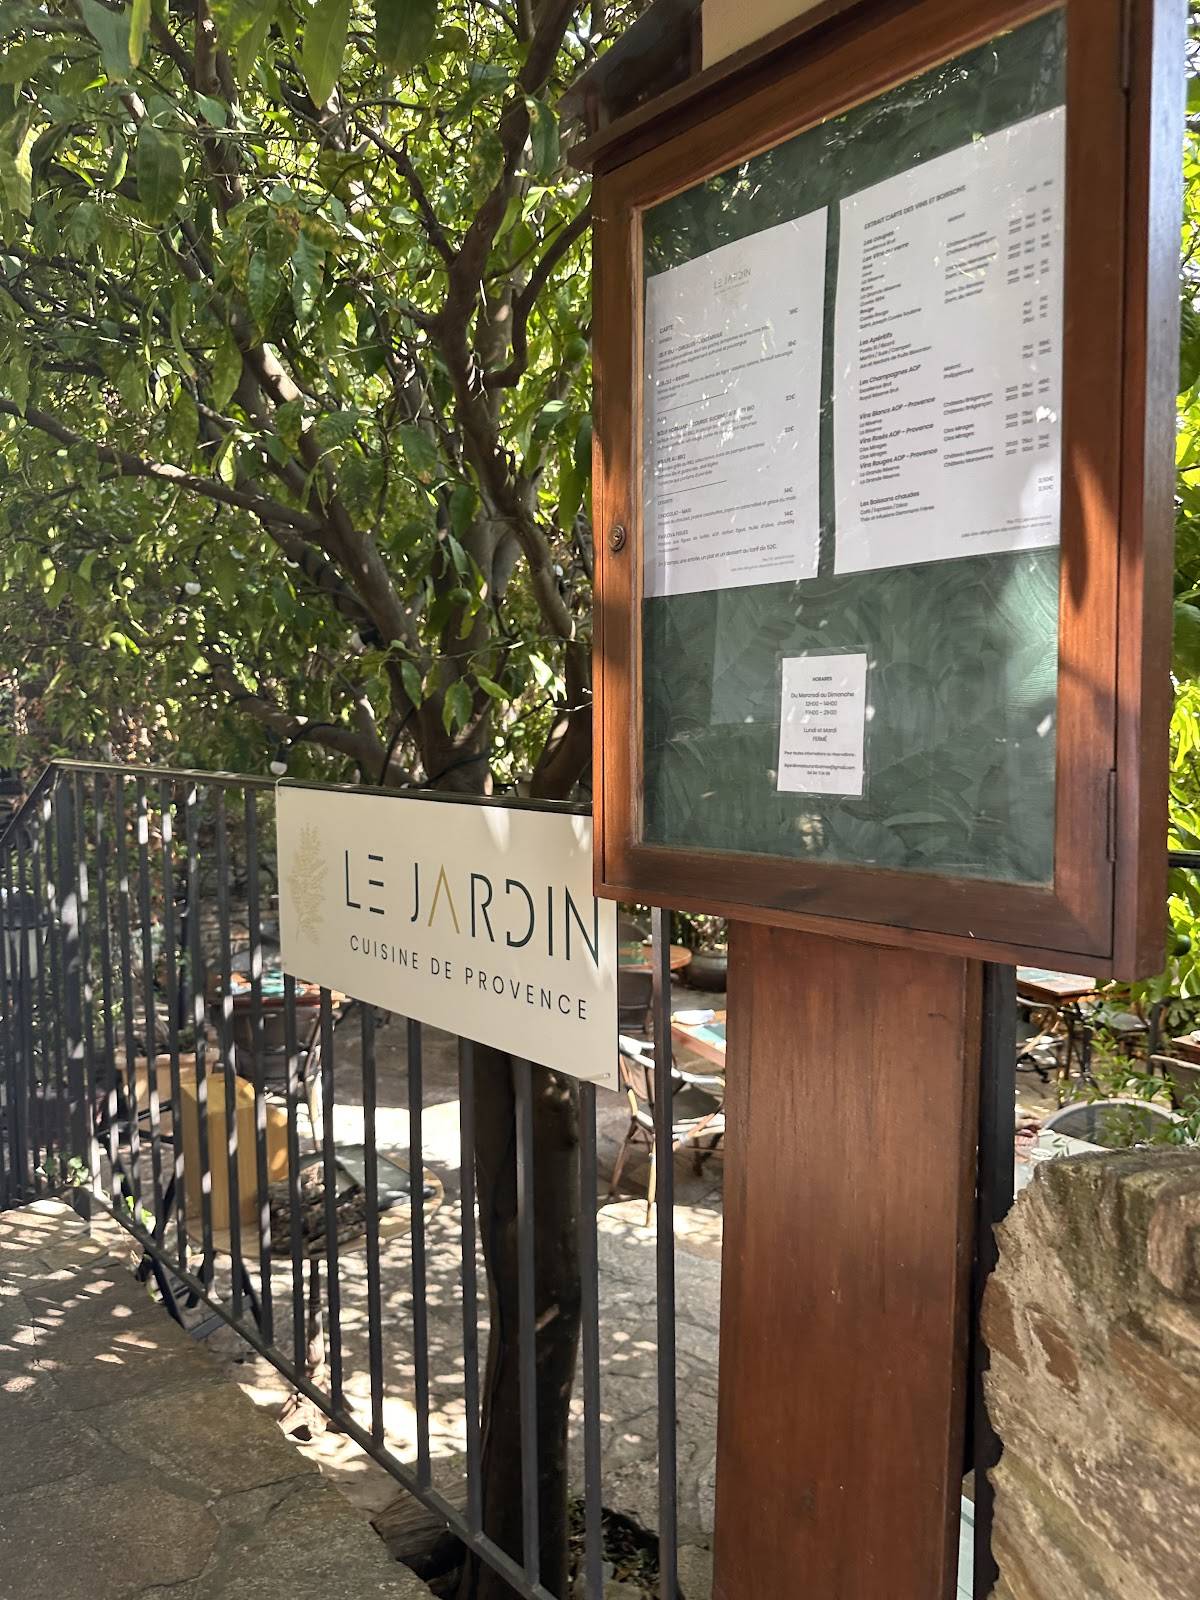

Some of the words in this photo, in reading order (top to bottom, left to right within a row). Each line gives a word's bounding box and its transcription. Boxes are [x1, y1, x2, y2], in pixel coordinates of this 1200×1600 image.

[345, 850, 385, 915] LE
[410, 862, 599, 968] JARDIN
[350, 935, 419, 970] CUISINE
[431, 957, 452, 980] DE
[465, 967, 587, 1021] PROVENCE
